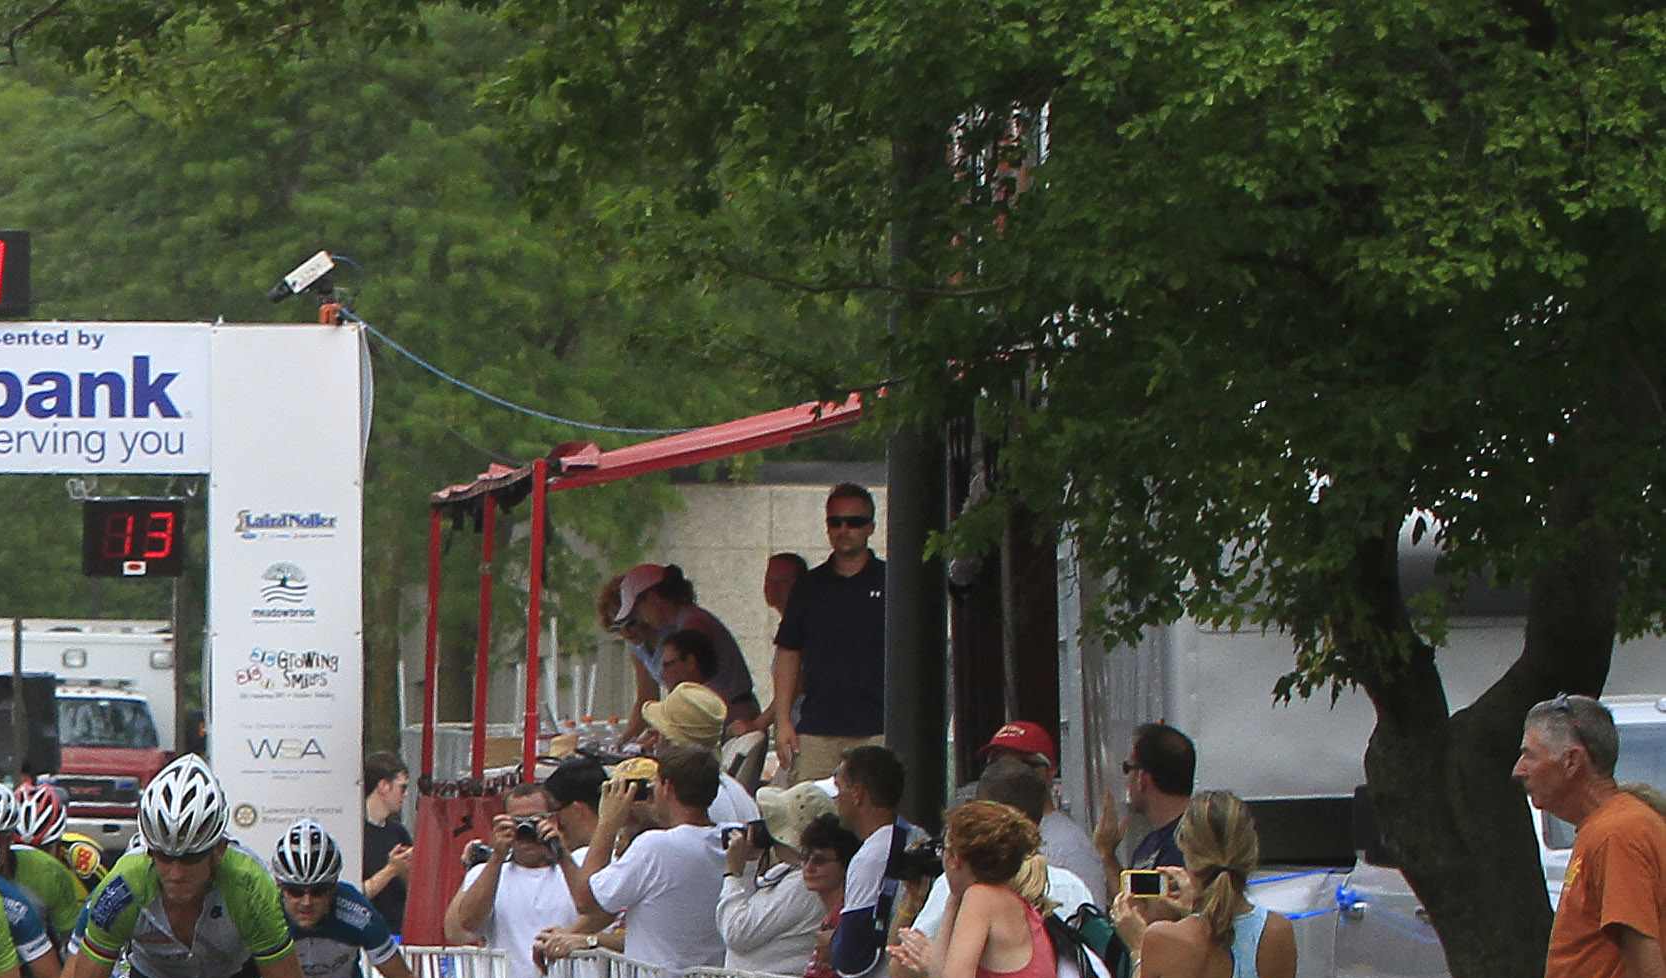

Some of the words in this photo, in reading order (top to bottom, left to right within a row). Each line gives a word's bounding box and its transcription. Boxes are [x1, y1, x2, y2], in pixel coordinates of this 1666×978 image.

[77, 329, 104, 349] by
[119, 430, 184, 463] you
[124, 511, 174, 558] 13
